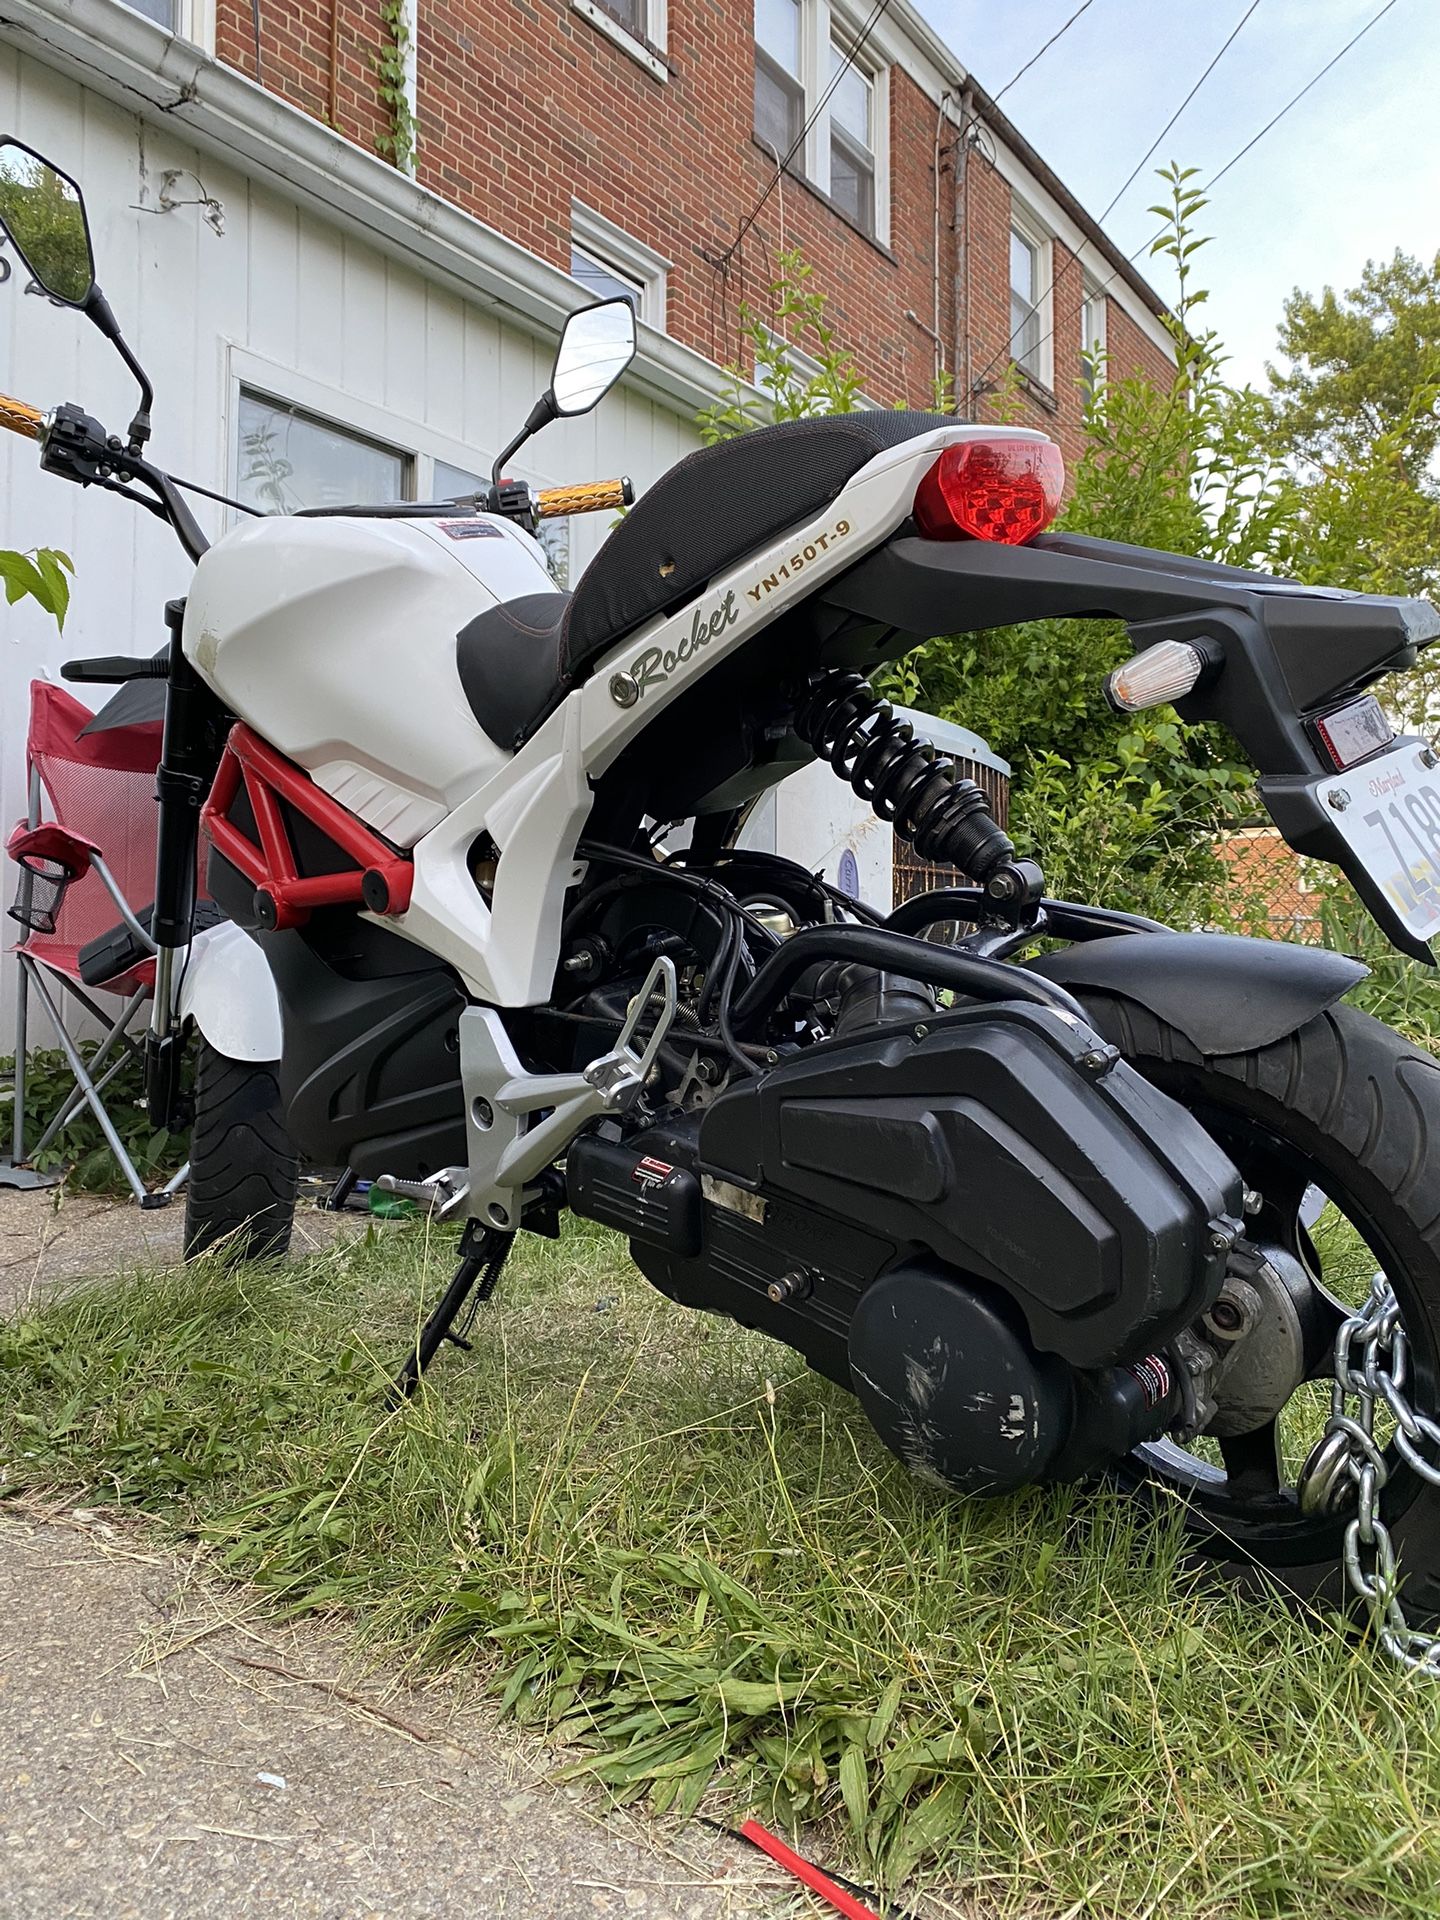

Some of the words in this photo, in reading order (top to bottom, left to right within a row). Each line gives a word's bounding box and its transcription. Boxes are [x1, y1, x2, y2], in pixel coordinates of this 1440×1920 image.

[748, 519, 850, 602] YN150T-9
[630, 589, 739, 698] Rocket
[1368, 767, 1406, 797] Maryland
